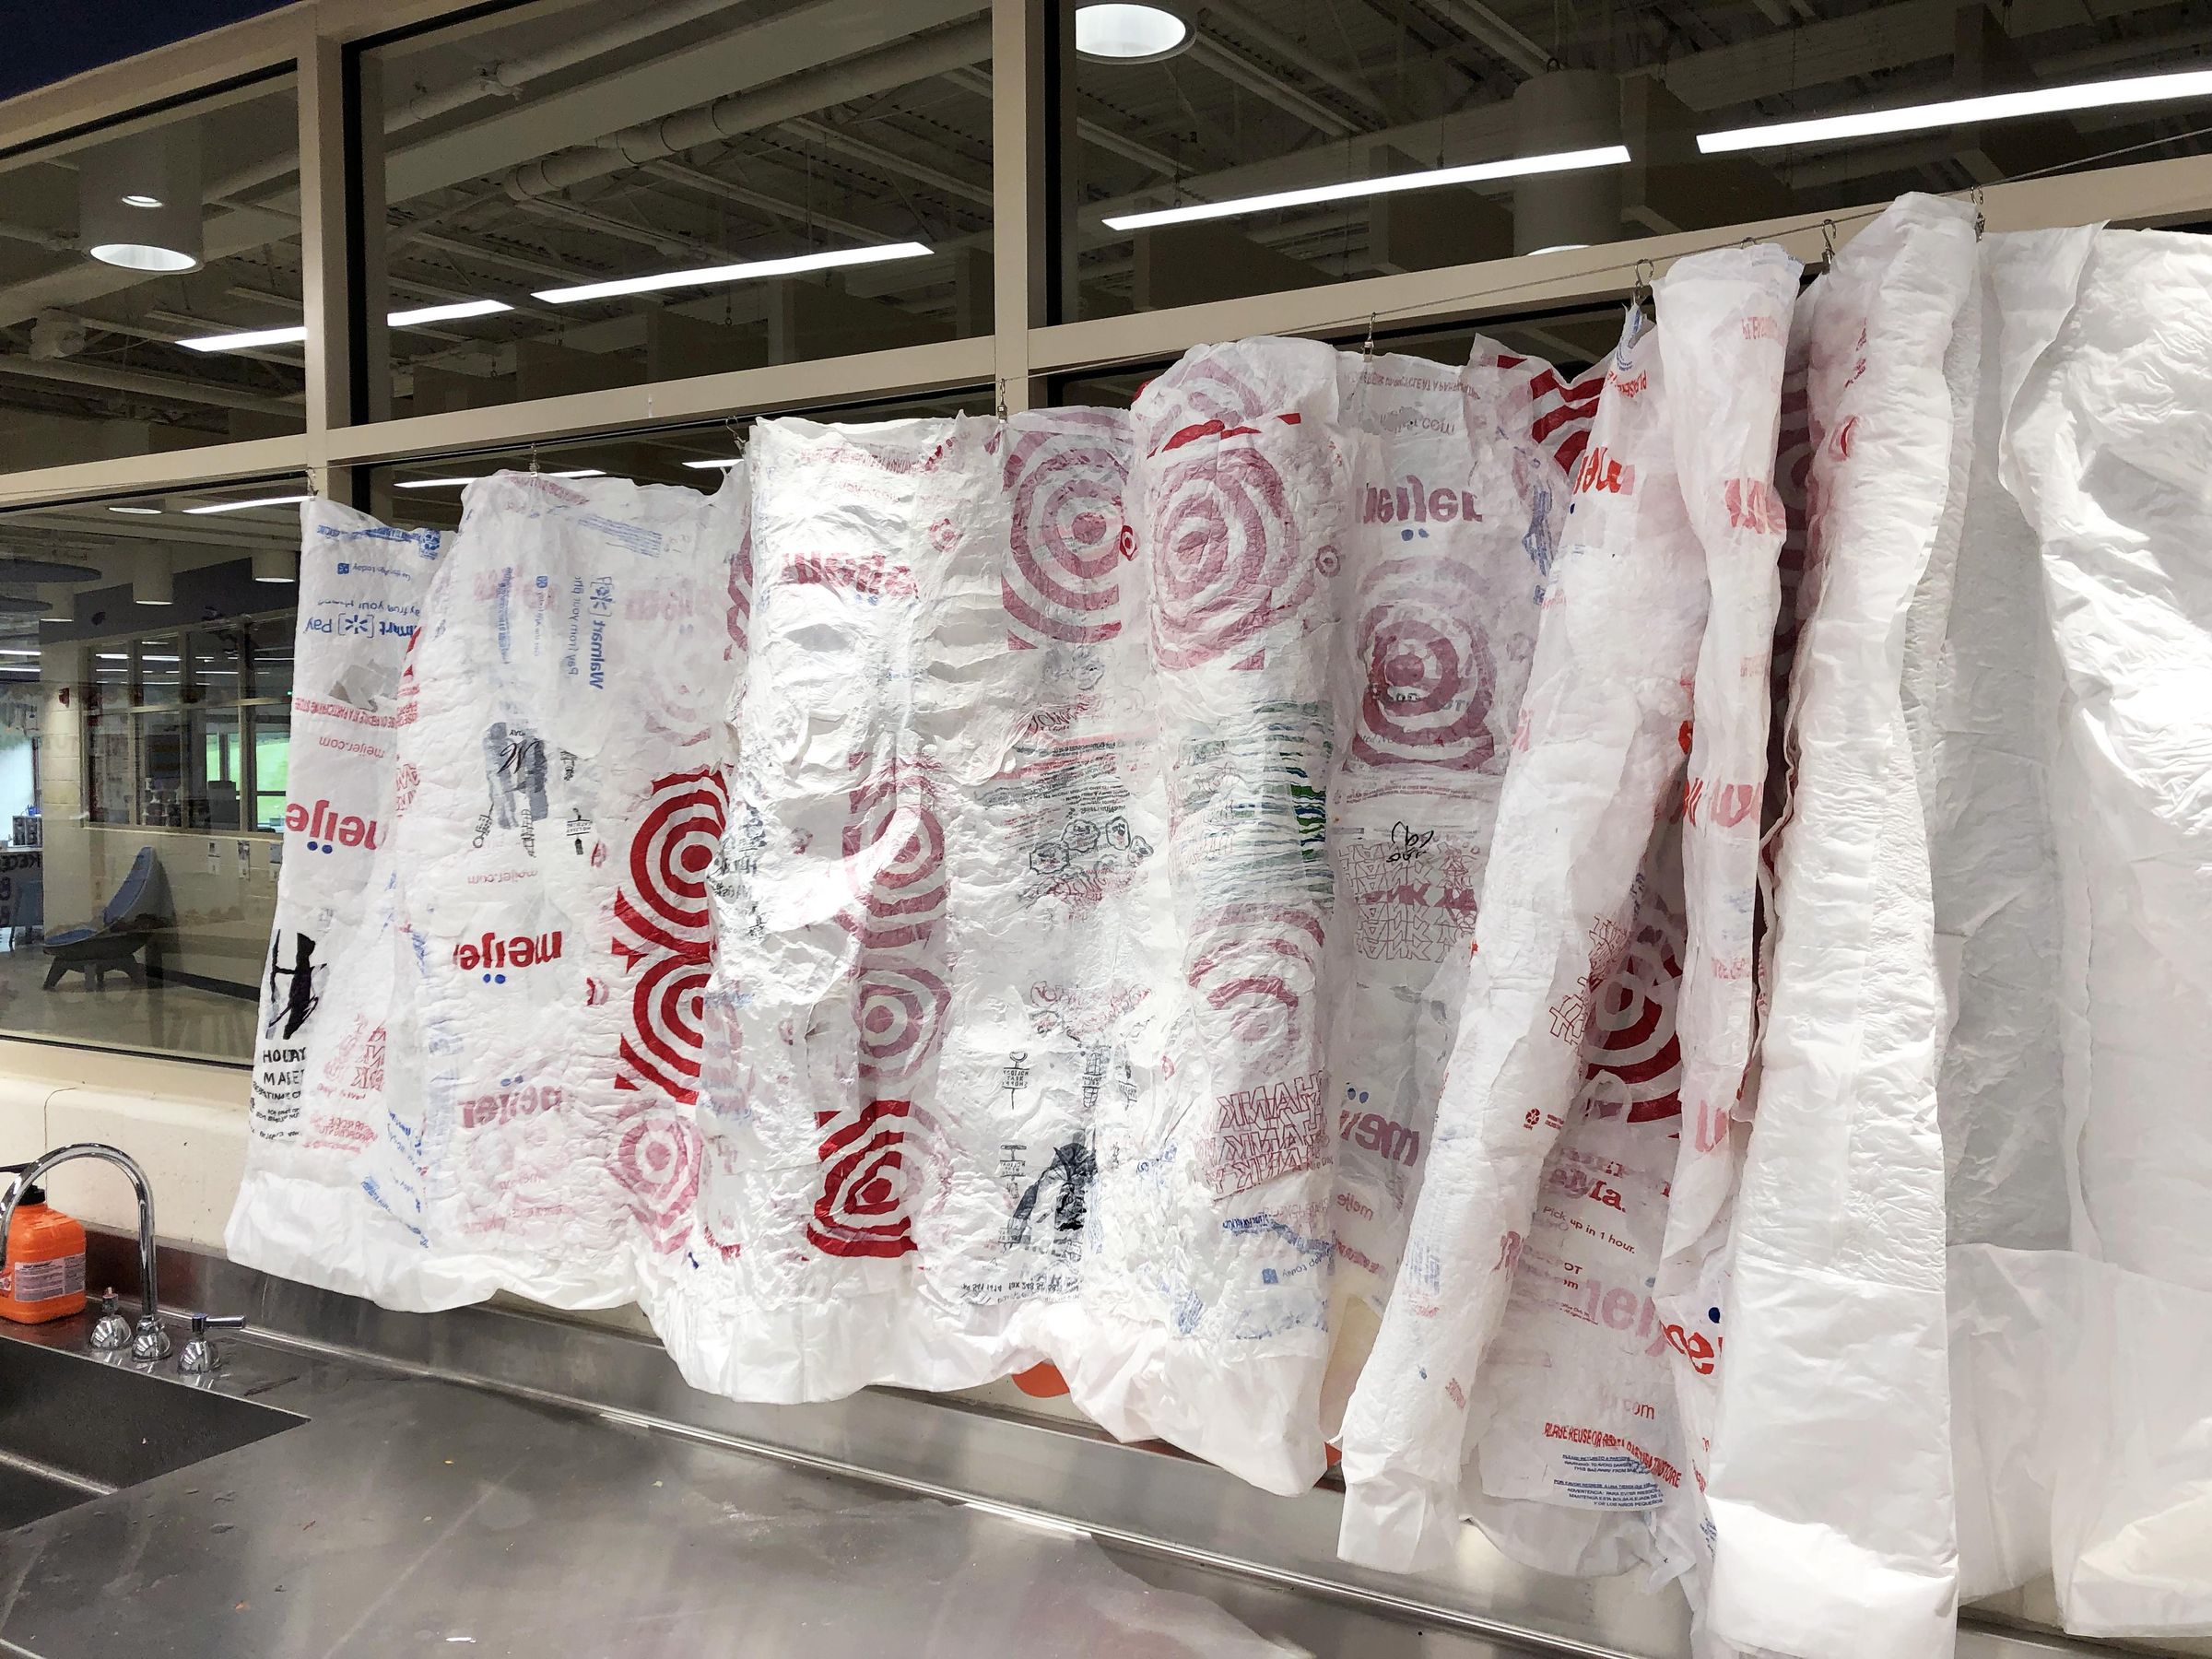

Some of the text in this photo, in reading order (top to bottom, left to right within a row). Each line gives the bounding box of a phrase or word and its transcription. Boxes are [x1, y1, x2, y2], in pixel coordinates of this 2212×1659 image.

[305, 618, 332, 634] Pay
[317, 736, 386, 761] meijer.com
[1542, 1205, 1636, 1254] Pick up in 1 hour.
[1568, 1427, 1592, 1445] REUSE
